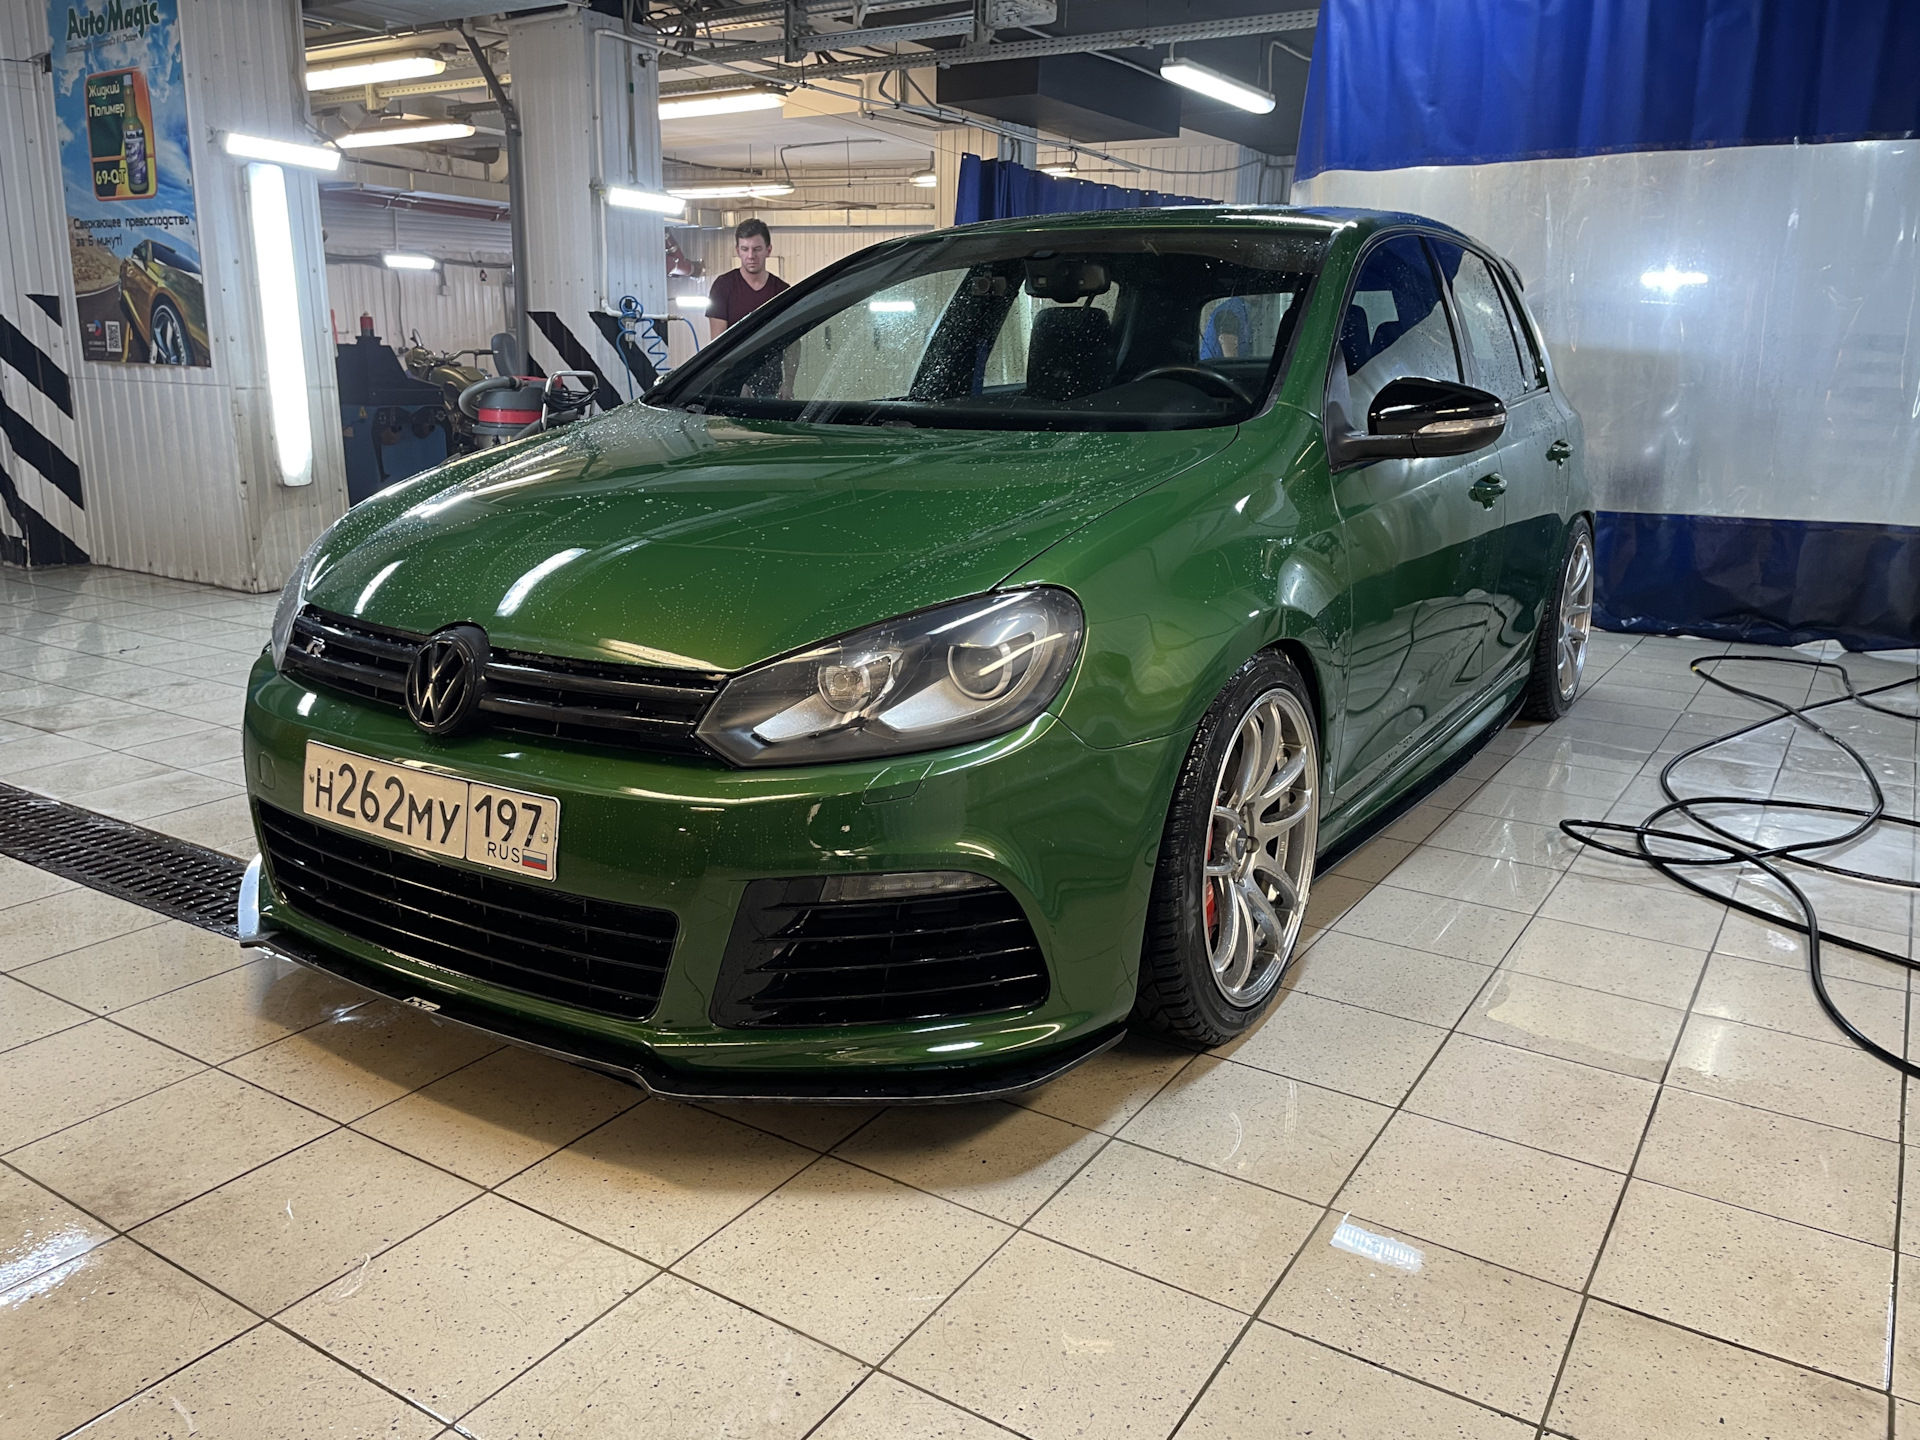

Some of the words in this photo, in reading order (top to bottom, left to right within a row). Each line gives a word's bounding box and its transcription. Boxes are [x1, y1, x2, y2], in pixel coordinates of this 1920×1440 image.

[88, 80, 120, 99] Жидкий
[89, 103, 125, 117] Полимер
[95, 168, 126, 185] 69-QT
[125, 215, 189, 231] превосходство
[474, 794, 542, 848] 197
[487, 841, 520, 864] RUS
